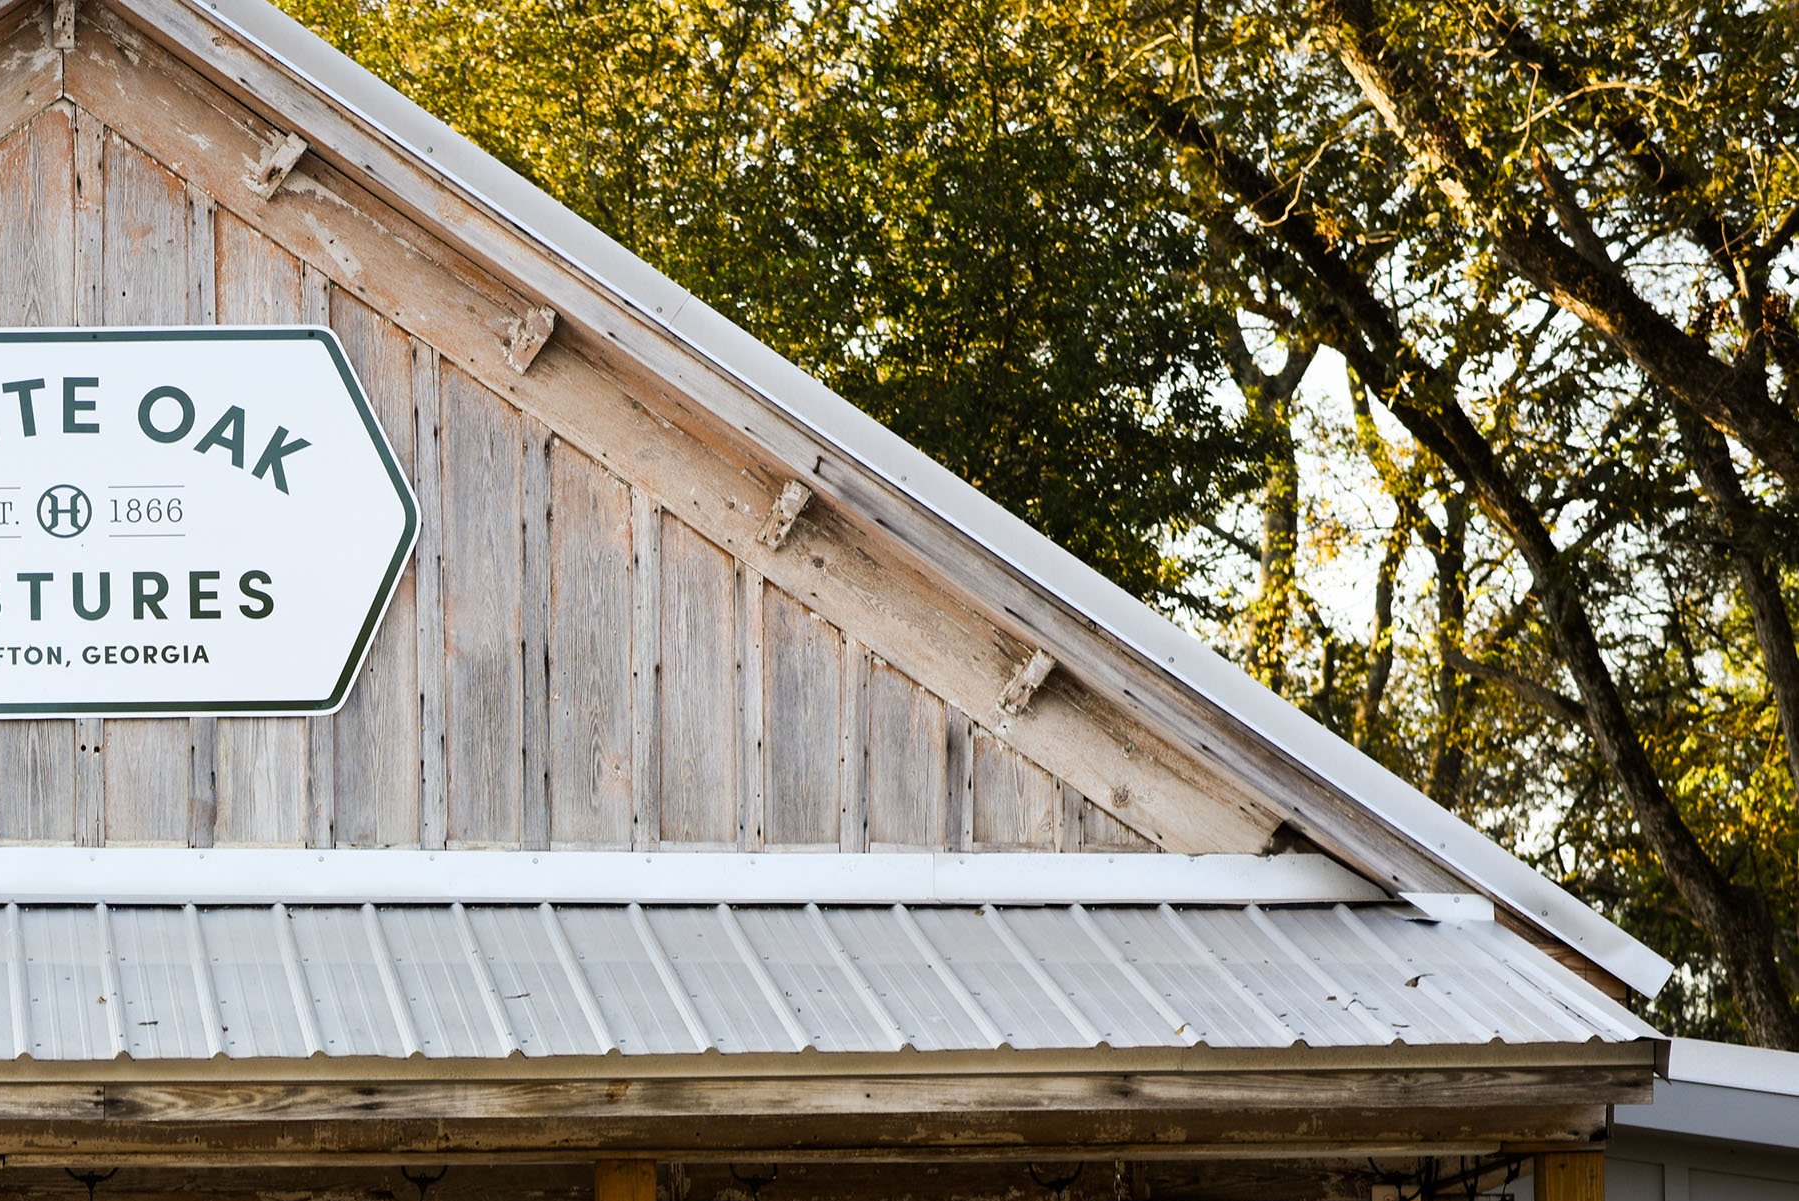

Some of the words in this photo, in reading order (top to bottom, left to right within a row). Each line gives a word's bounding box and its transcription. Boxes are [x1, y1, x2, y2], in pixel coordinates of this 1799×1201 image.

[137, 385, 313, 496] OAK
[109, 498, 184, 524] 1866
[82, 644, 210, 665] GEORGIA
